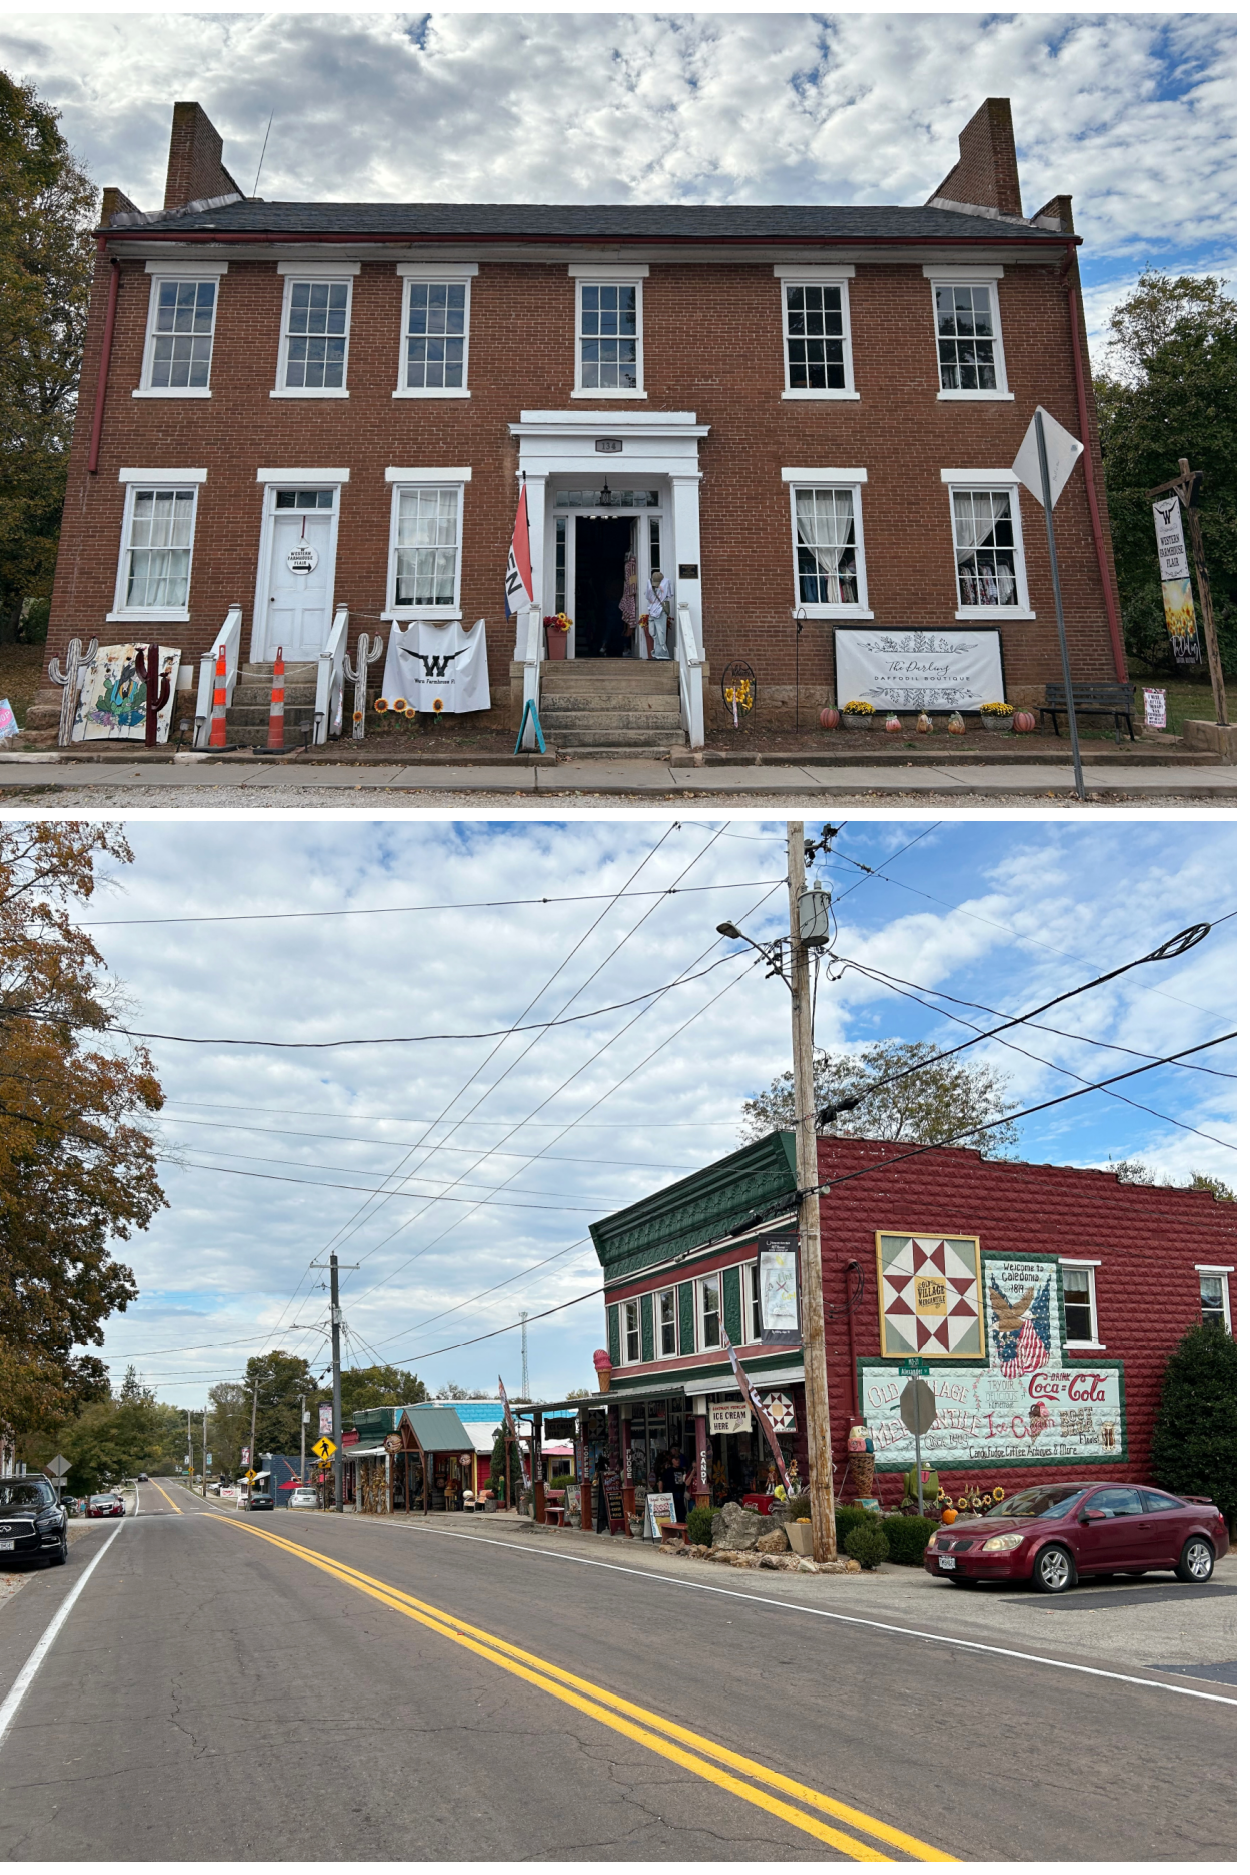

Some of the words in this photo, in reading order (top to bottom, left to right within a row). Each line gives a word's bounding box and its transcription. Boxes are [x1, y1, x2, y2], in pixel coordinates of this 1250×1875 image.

[601, 442, 616, 450] 134
[1160, 536, 1180, 546] WESTERN
[1159, 544, 1184, 558] FARMHOUSE
[1166, 556, 1180, 568] FLAIR
[886, 661, 905, 672] The
[906, 661, 950, 676] Darling
[1003, 1263, 1035, 1271] Welcome
[1001, 1271, 1040, 1282] Caledonia
[921, 1281, 931, 1289] OLD
[917, 1285, 945, 1299] VILLAGE
[918, 1295, 946, 1307] MERCANTILE
[1050, 1373, 1070, 1382] DRINK
[987, 1381, 1000, 1391] TRY
[1000, 1381, 1015, 1390] OUR
[867, 1382, 900, 1408] OLD
[985, 1391, 1017, 1401] DELICIOUS
[713, 1412, 723, 1420] ICE
[725, 1411, 746, 1420] CREAM
[1060, 1407, 1093, 1424] ROOT
[713, 1422, 729, 1431] HERE
[983, 1411, 1008, 1439] Ice
[1060, 1420, 1096, 1438] BEER
[1053, 1445, 1058, 1455] &
[1059, 1444, 1077, 1455] More
